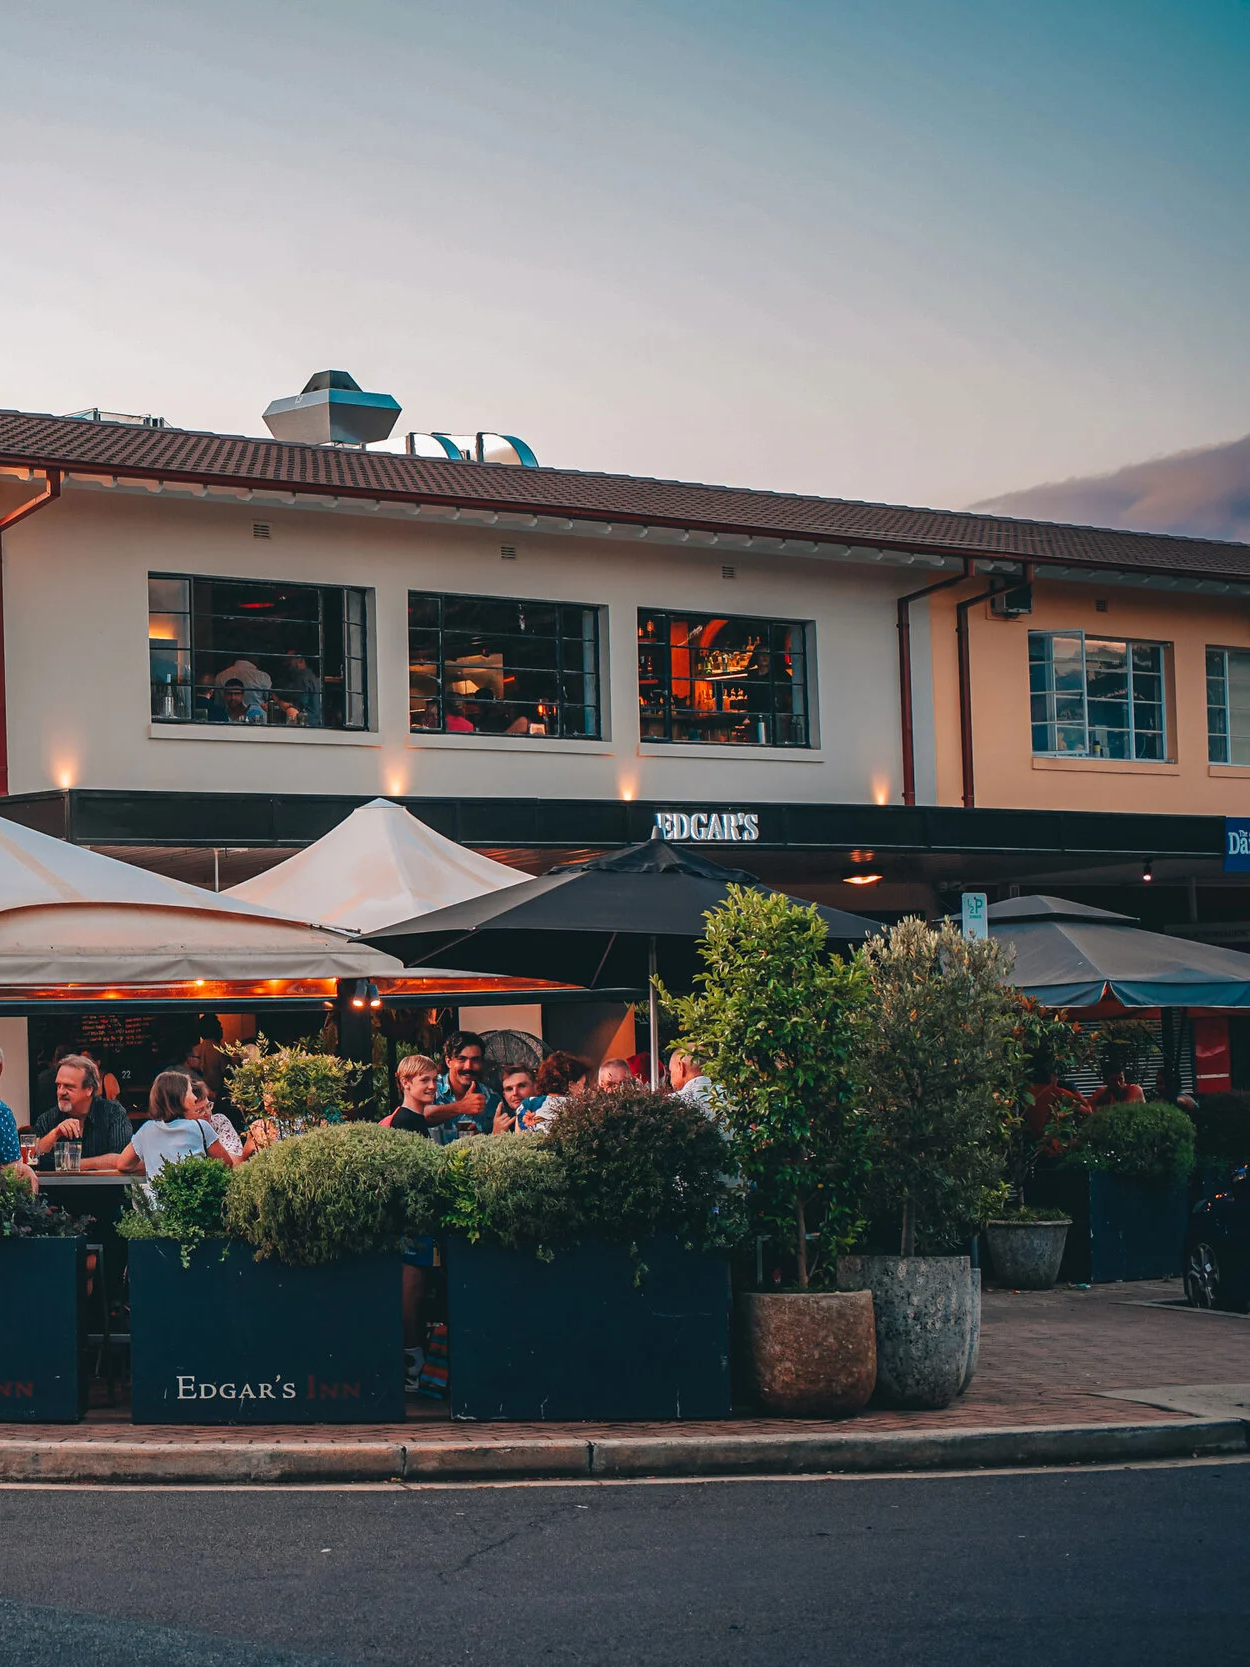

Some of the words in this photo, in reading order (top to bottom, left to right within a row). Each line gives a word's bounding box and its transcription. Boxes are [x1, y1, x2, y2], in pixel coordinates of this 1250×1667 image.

[655, 813, 759, 840] EDGAR'S
[121, 1070, 131, 1079] 22
[176, 1374, 297, 1399] EDGAR'S
[306, 1374, 361, 1399] INN
